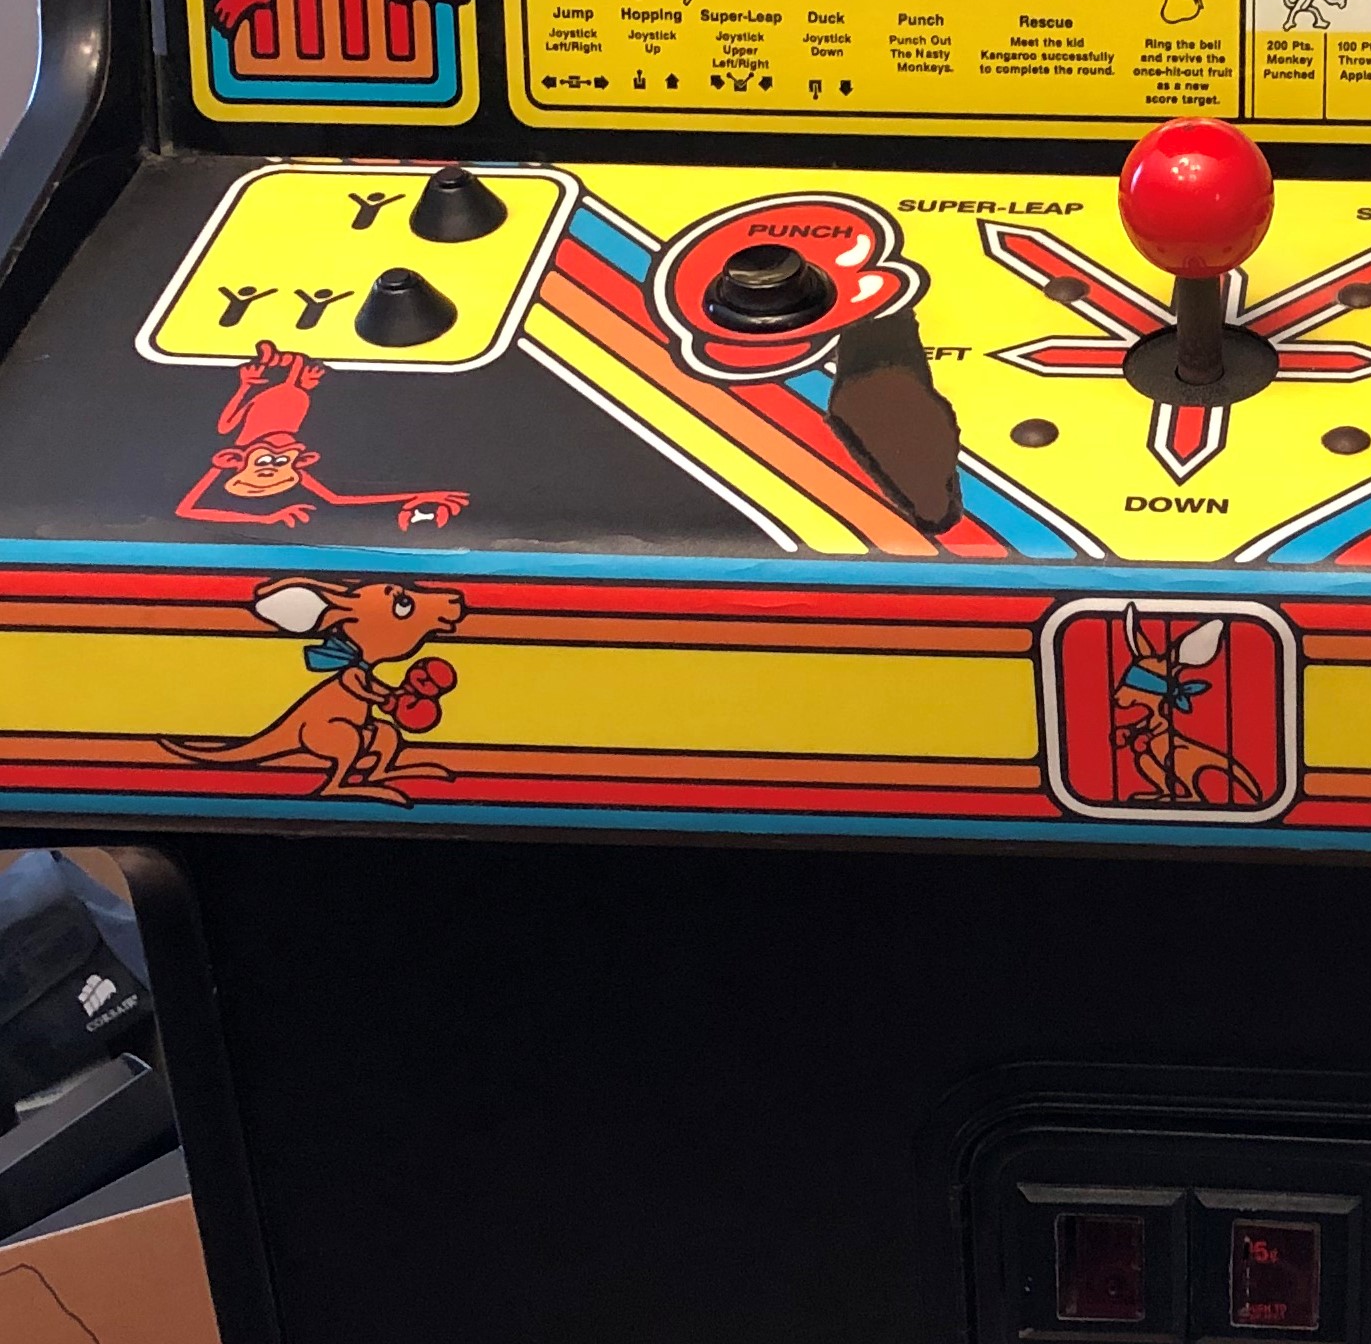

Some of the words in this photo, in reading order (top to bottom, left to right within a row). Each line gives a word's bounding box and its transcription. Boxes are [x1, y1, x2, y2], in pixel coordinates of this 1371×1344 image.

[553, 7, 594, 21] Jump
[621, 9, 682, 23] Hopping
[700, 10, 782, 25] Super-Leap
[807, 12, 845, 24] Duck
[898, 13, 944, 27] Punch
[1019, 15, 1073, 29] Rescue
[549, 28, 597, 40] Joystick
[628, 30, 677, 42] Joystick
[715, 31, 764, 43] Joystick
[802, 33, 851, 45] Joystick
[889, 35, 926, 45] Punch
[931, 36, 952, 46] Out
[1010, 37, 1039, 47] Meet
[1043, 38, 1062, 47] the
[1067, 38, 1084, 48] kid
[1145, 39, 1172, 51] Ring
[1176, 39, 1195, 50] the
[1200, 40, 1221, 50] bell
[1266, 40, 1288, 51] 200
[1292, 41, 1314, 52] Pts.
[1338, 41, 1357, 52] 100
[545, 41, 602, 53] Left/Right
[645, 43, 661, 55] Up
[722, 45, 758, 57] Upper
[811, 46, 844, 57] Down
[890, 49, 912, 59] The
[981, 50, 1037, 62] Kangaroo
[1041, 52, 1114, 64] successfully
[1141, 53, 1162, 63] and
[1167, 54, 1202, 63] revive
[1206, 54, 1226, 63] the
[712, 58, 769, 70] Left/Right
[1266, 54, 1313, 68] Monkey
[897, 62, 954, 75] Monkeys.
[980, 64, 992, 74] to
[996, 65, 1050, 76] complete
[1054, 65, 1073, 75] the
[1077, 66, 1115, 75] round.
[1133, 67, 1204, 77] once-hit-out
[1208, 68, 1233, 77] fruit
[1263, 69, 1315, 81] Punched
[1157, 82, 1170, 90] as
[1185, 83, 1209, 91] new
[1146, 96, 1178, 104] score
[1182, 95, 1220, 106] target.
[897, 198, 1084, 216] SUPER-LEAP
[747, 223, 853, 240] PUNCH
[923, 346, 972, 361] EFT
[1124, 496, 1229, 514] DOWN
